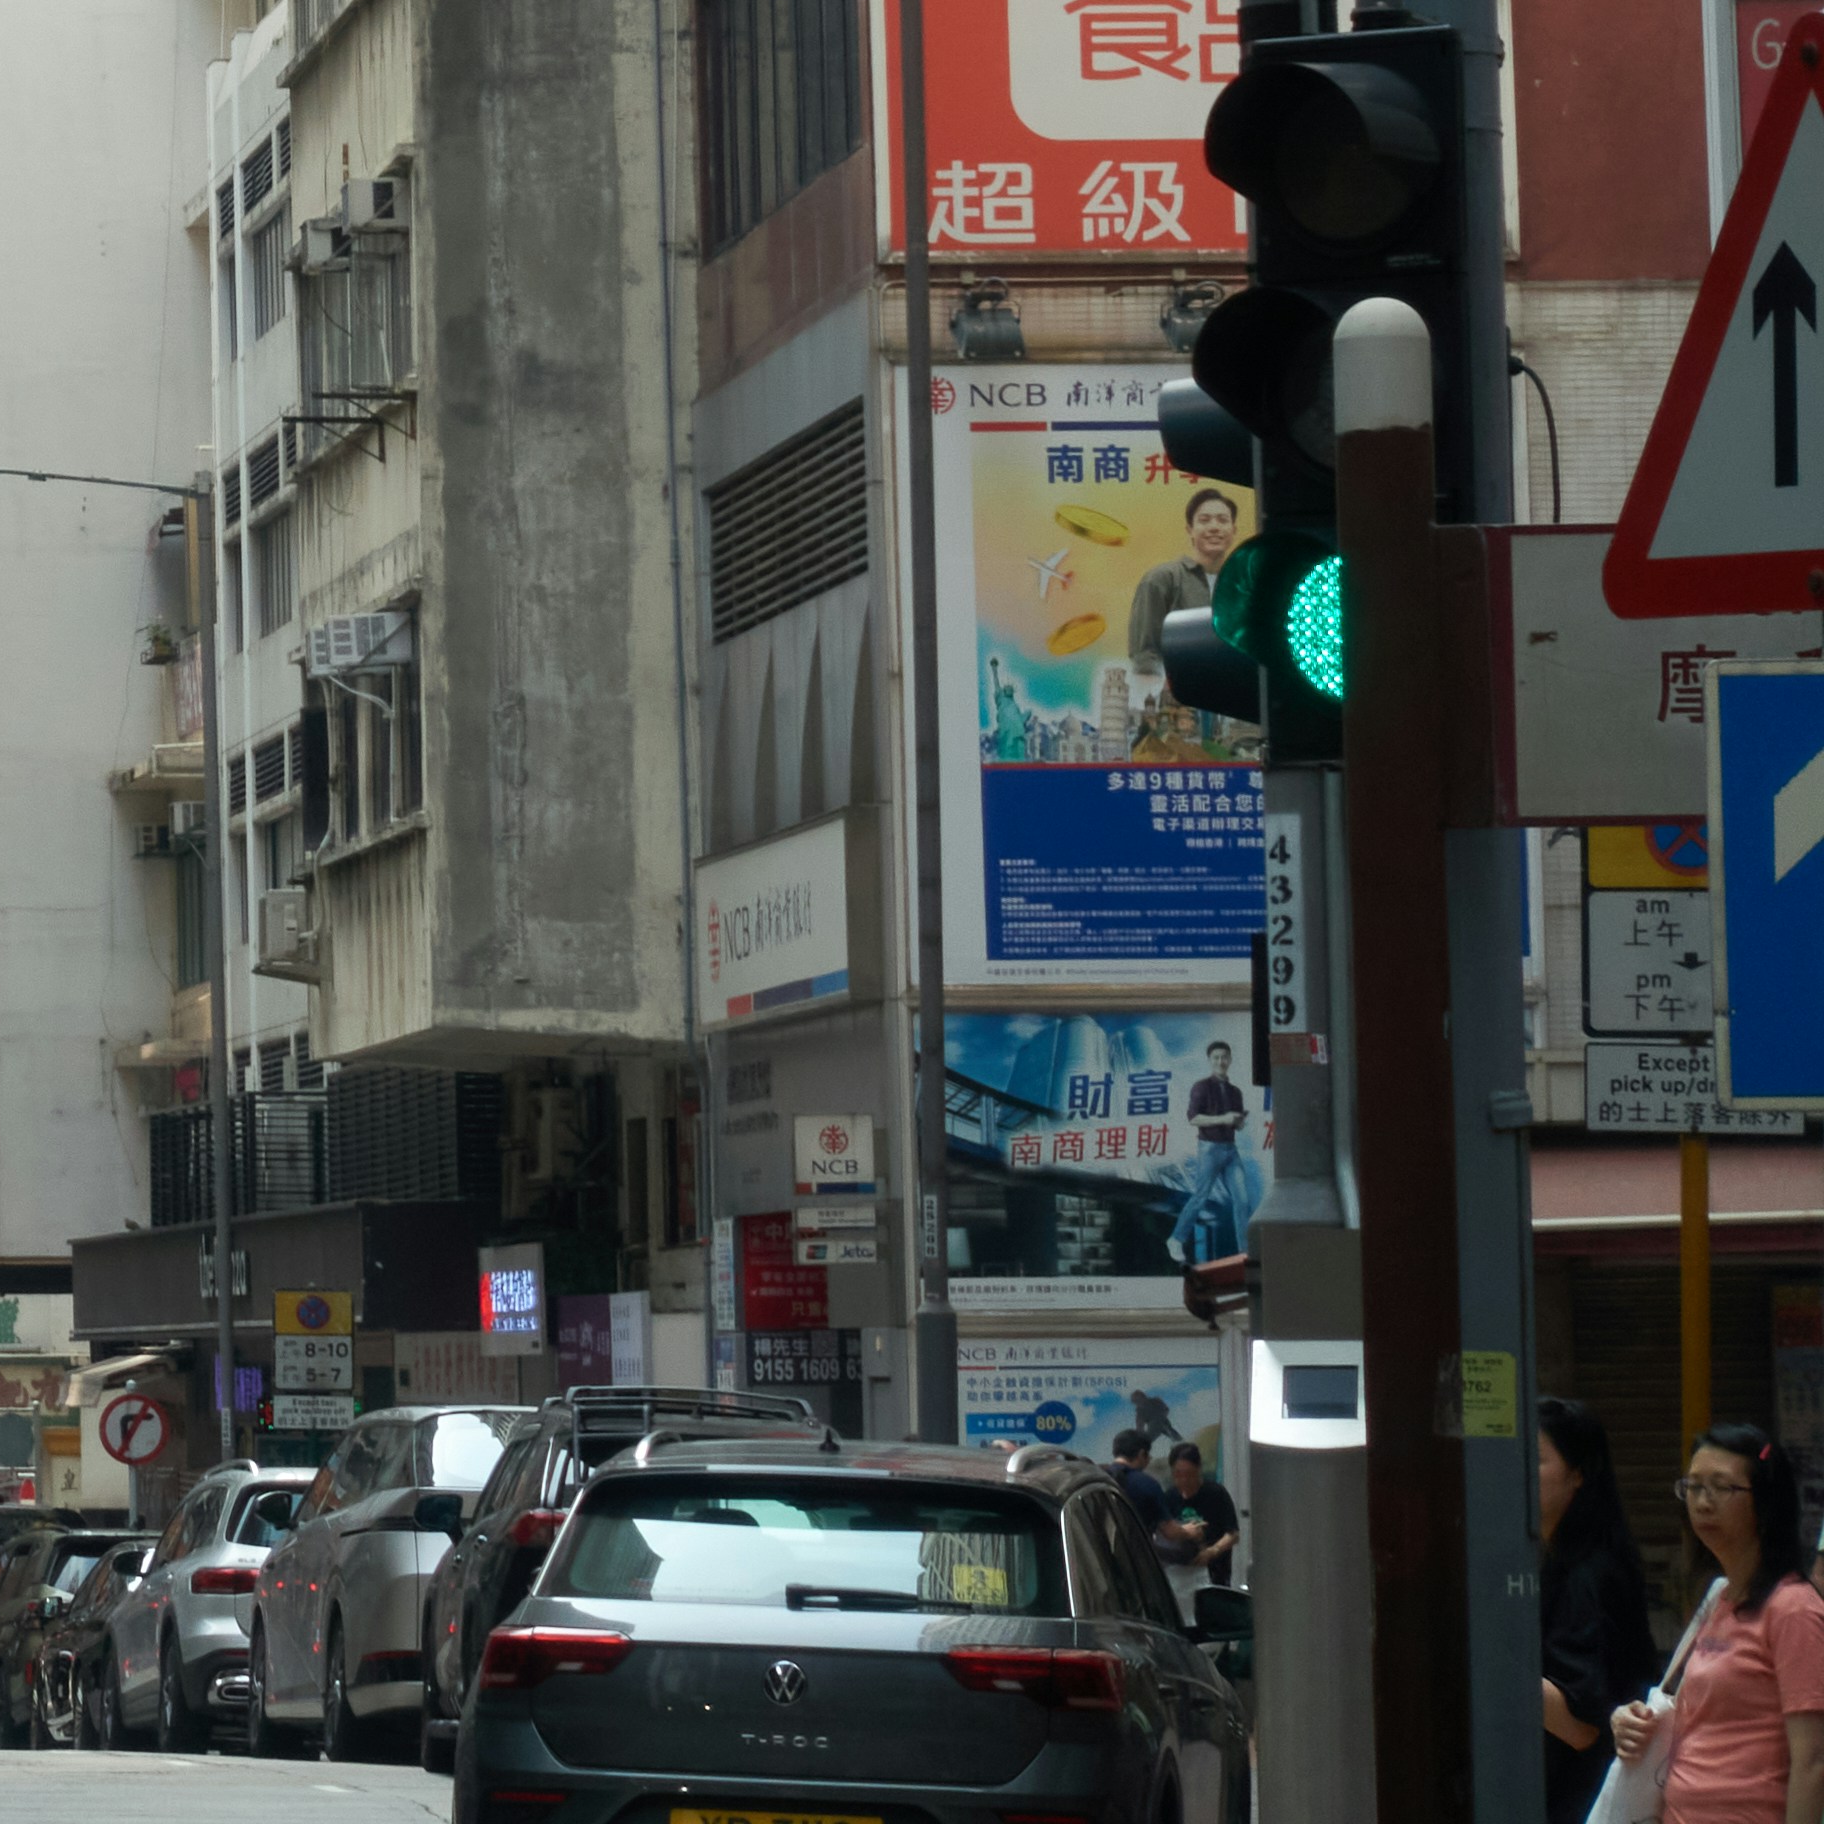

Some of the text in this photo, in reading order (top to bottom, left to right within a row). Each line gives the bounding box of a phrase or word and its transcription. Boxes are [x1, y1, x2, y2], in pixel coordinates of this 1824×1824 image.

[929, 160, 1248, 245] 超級
[970, 383, 1047, 408] NCB
[1046, 444, 1131, 485] 南商
[1636, 898, 1670, 914] am
[1268, 833, 1296, 1027] 43299
[1624, 920, 1684, 947] 上午
[1636, 972, 1672, 992] pm
[1625, 994, 1684, 1022] 下午
[1638, 1053, 1710, 1075] Except
[1068, 1070, 1171, 1121] 財富
[1610, 1075, 1654, 1095] pick
[1011, 1123, 1171, 1168] 南商理財
[811, 1159, 859, 1176] NCB
[958, 1348, 997, 1361] NCB
[753, 1358, 841, 1382] 9155 1609
[1036, 1415, 1072, 1431] 80%
[740, 1733, 829, 1749] T-ROC
